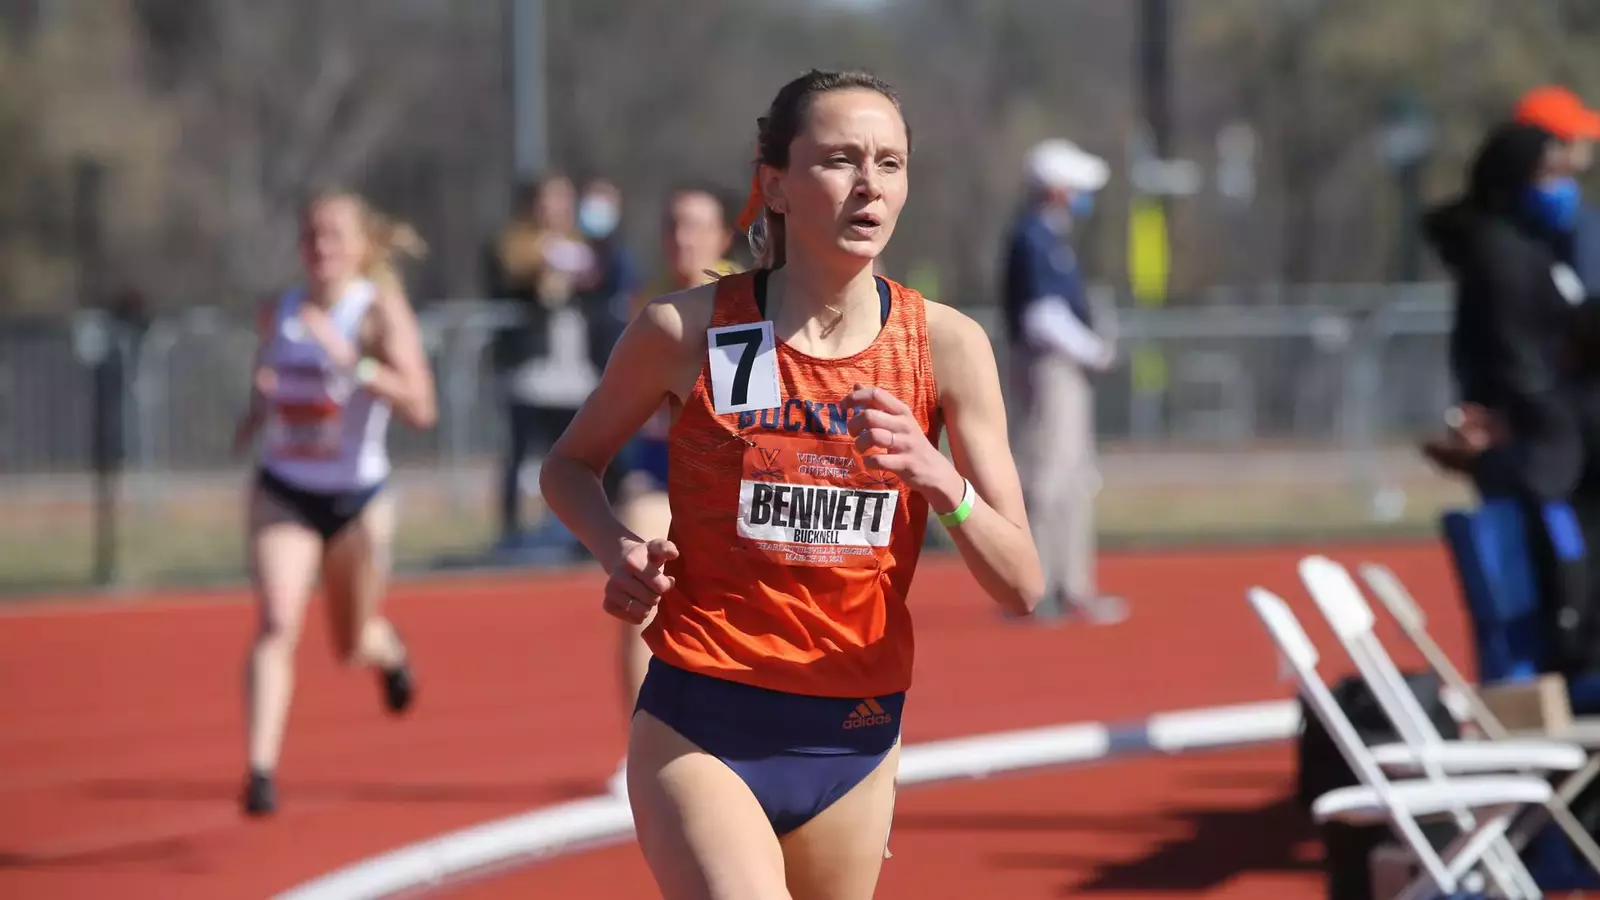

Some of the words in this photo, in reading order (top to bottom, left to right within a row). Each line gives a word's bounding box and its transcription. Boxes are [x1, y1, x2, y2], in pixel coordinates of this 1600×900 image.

[715, 328, 763, 406] 7
[796, 452, 856, 468] VIRGINIA
[798, 465, 851, 479] OPENER
[750, 483, 890, 533] BENNETT
[794, 529, 840, 544] BUCKNELL
[842, 713, 892, 729] adidas
